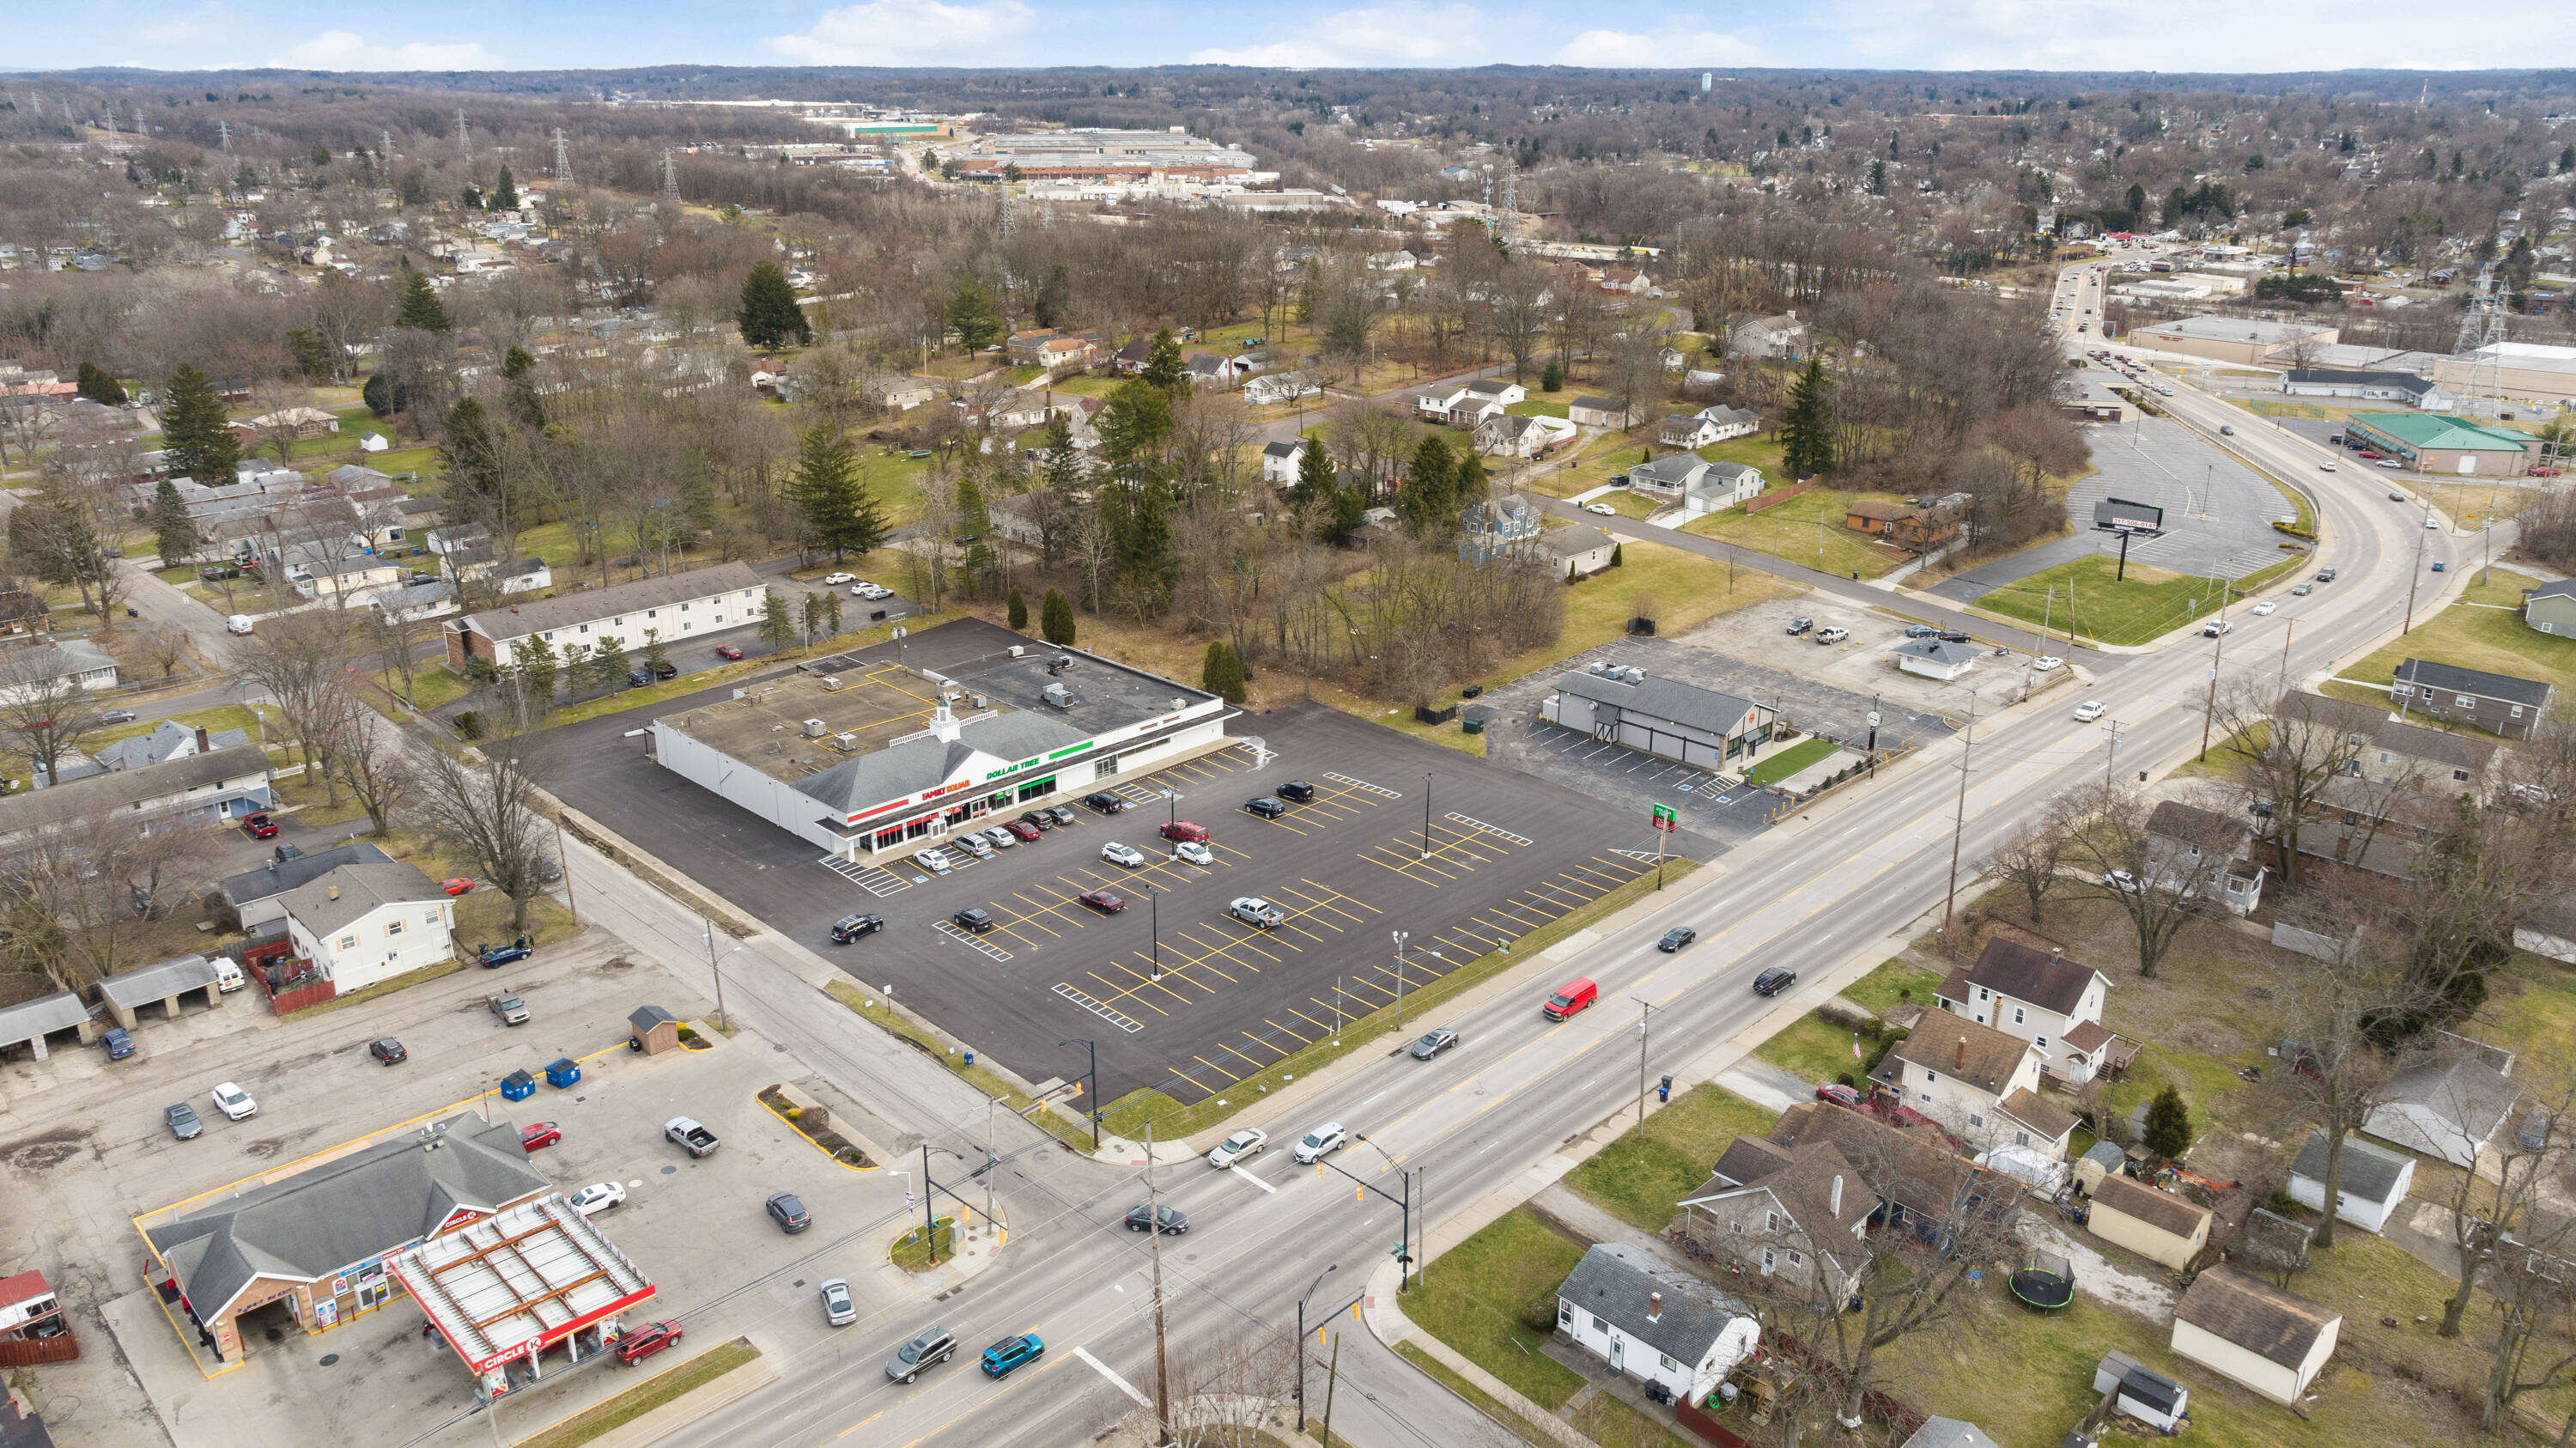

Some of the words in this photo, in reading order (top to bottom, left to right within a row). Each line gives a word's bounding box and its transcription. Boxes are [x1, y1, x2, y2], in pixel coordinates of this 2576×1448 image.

[987, 764, 1018, 780] DOLLAR
[1021, 757, 1040, 769] TREE
[922, 787, 945, 800] FAMILY
[946, 780, 970, 793] DOLLAR
[445, 1214, 467, 1227] CIRCLE
[484, 1345, 525, 1368] CIRCLE
